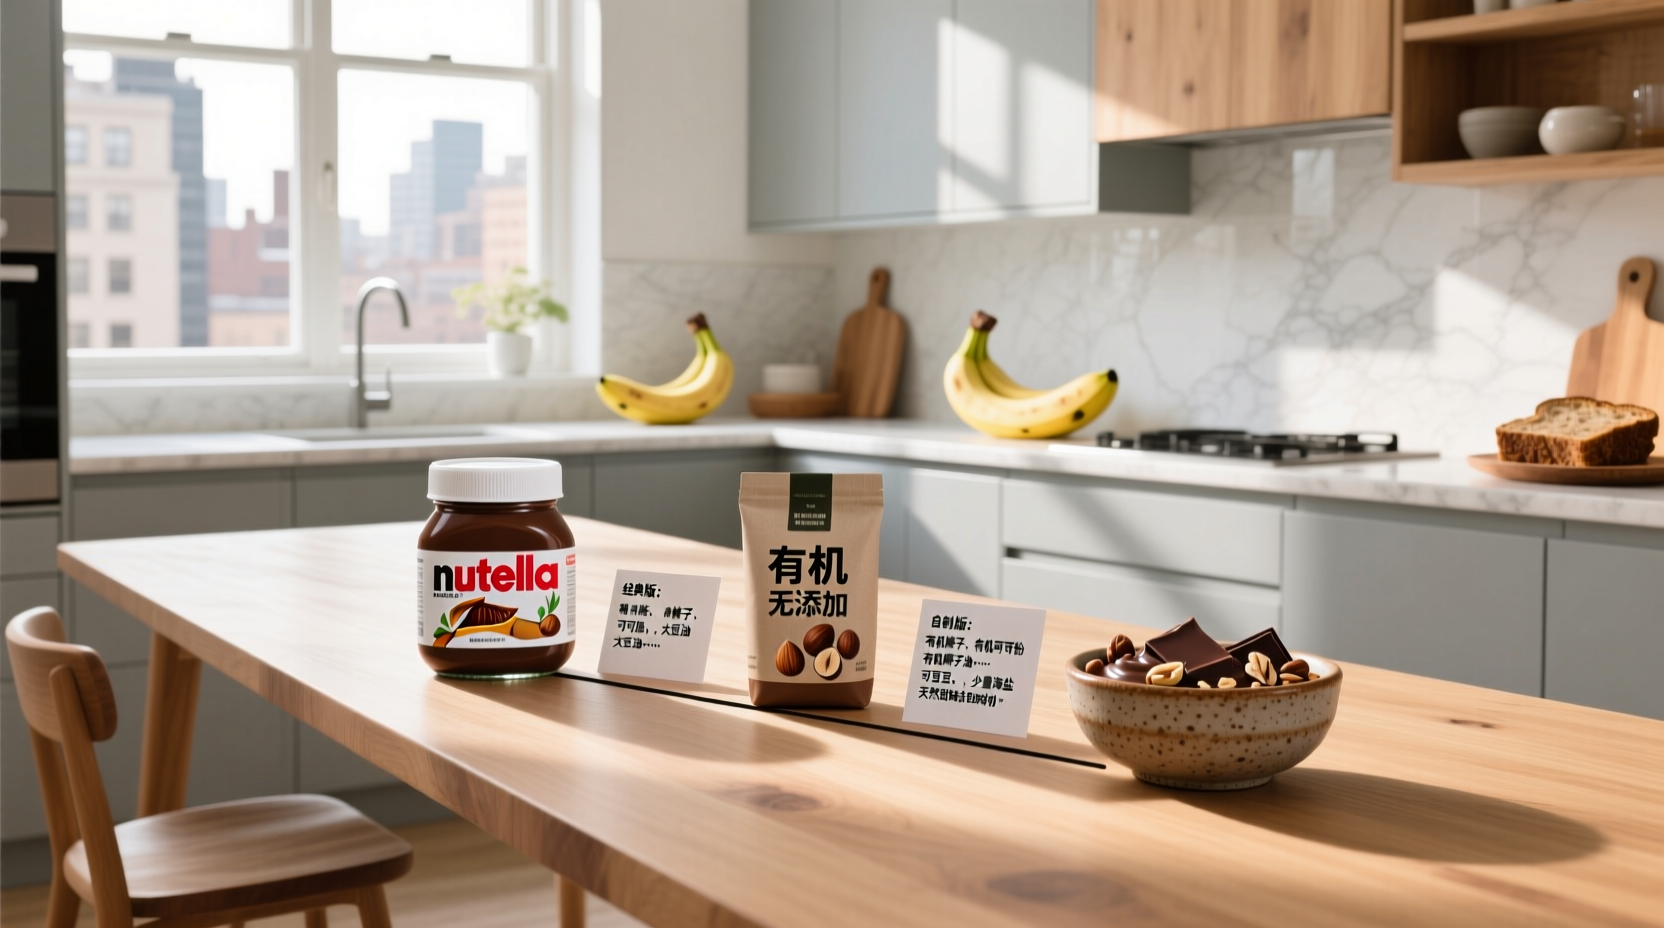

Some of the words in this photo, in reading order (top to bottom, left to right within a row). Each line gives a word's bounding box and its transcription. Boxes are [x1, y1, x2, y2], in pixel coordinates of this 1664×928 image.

[433, 554, 559, 592] nutella
[768, 545, 848, 585] 有机
[768, 590, 848, 618] 无添加
